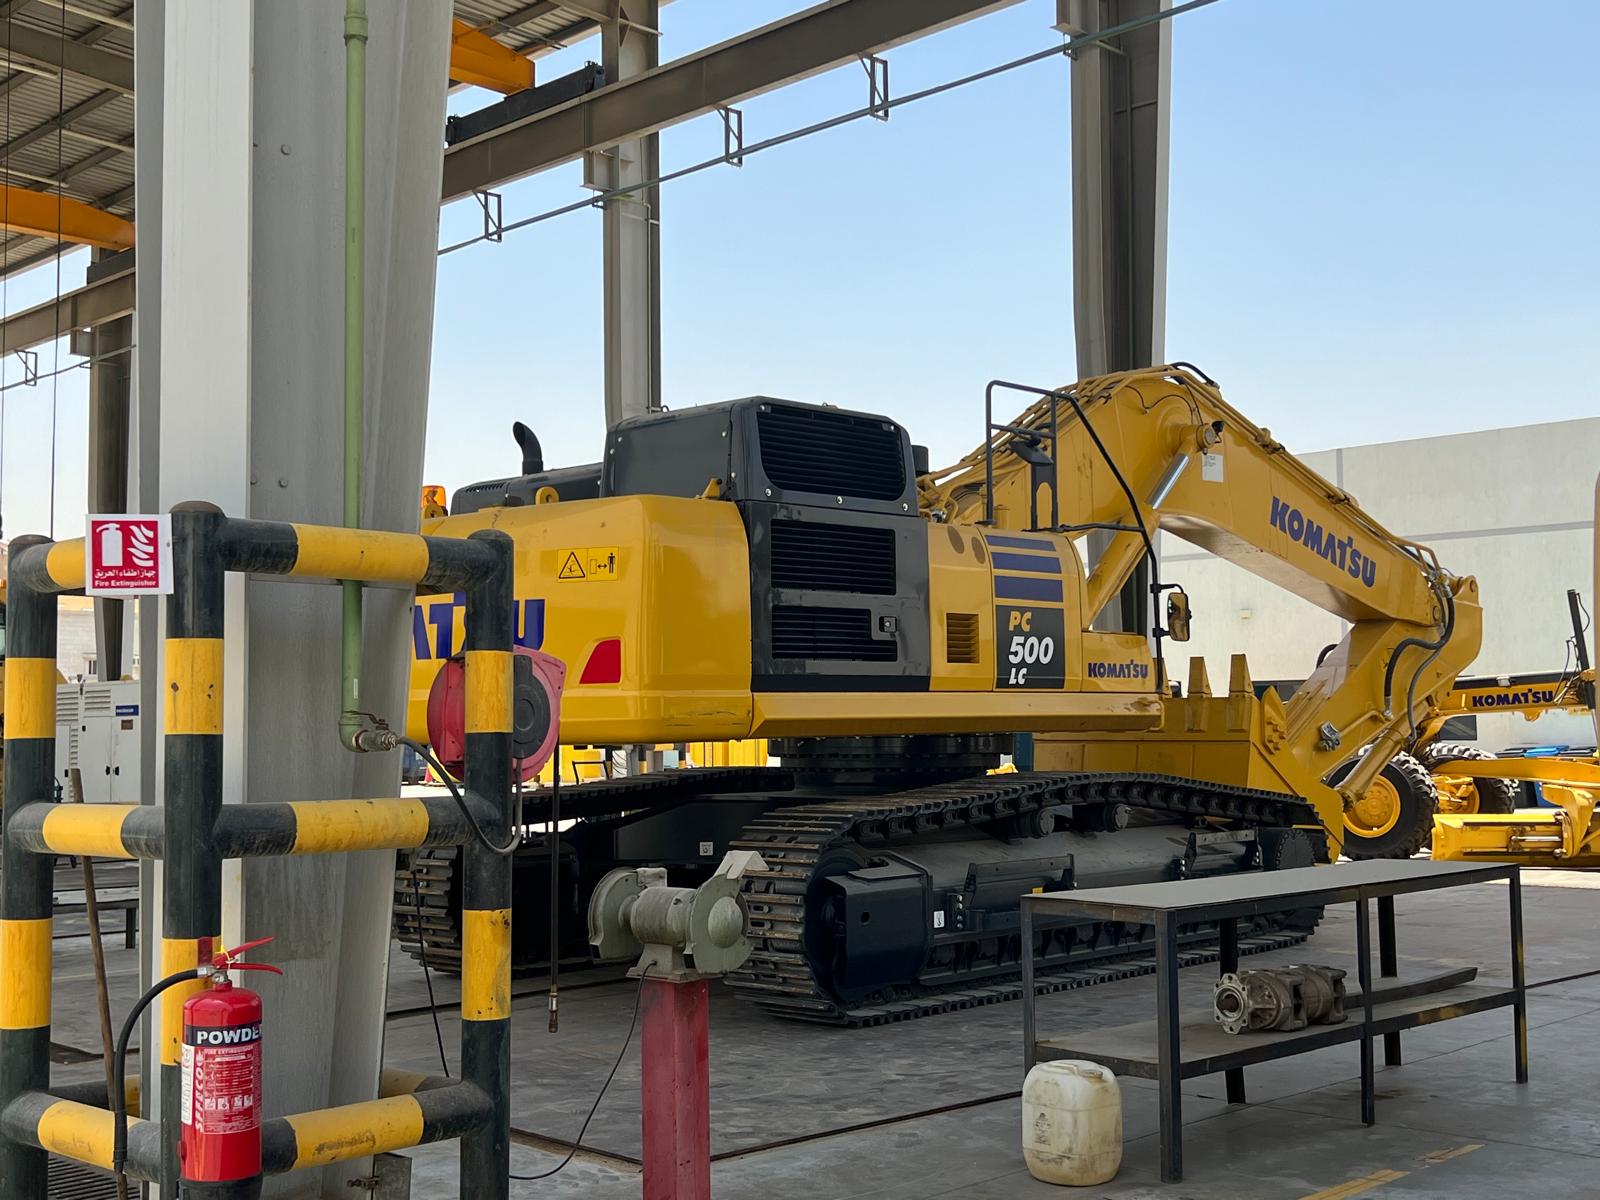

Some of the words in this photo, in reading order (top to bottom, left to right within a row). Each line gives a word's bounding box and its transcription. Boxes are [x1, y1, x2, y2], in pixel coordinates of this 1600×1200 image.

[1270, 496, 1376, 588] KOMATSU
[95, 569, 119, 579] الحريق
[1008, 611, 1032, 632] PC
[1009, 636, 1054, 664] 500
[1009, 668, 1027, 684] LC
[1088, 659, 1148, 678] KOMATSU
[1472, 688, 1553, 707] KOMATSU
[197, 1027, 262, 1044] POWDE
